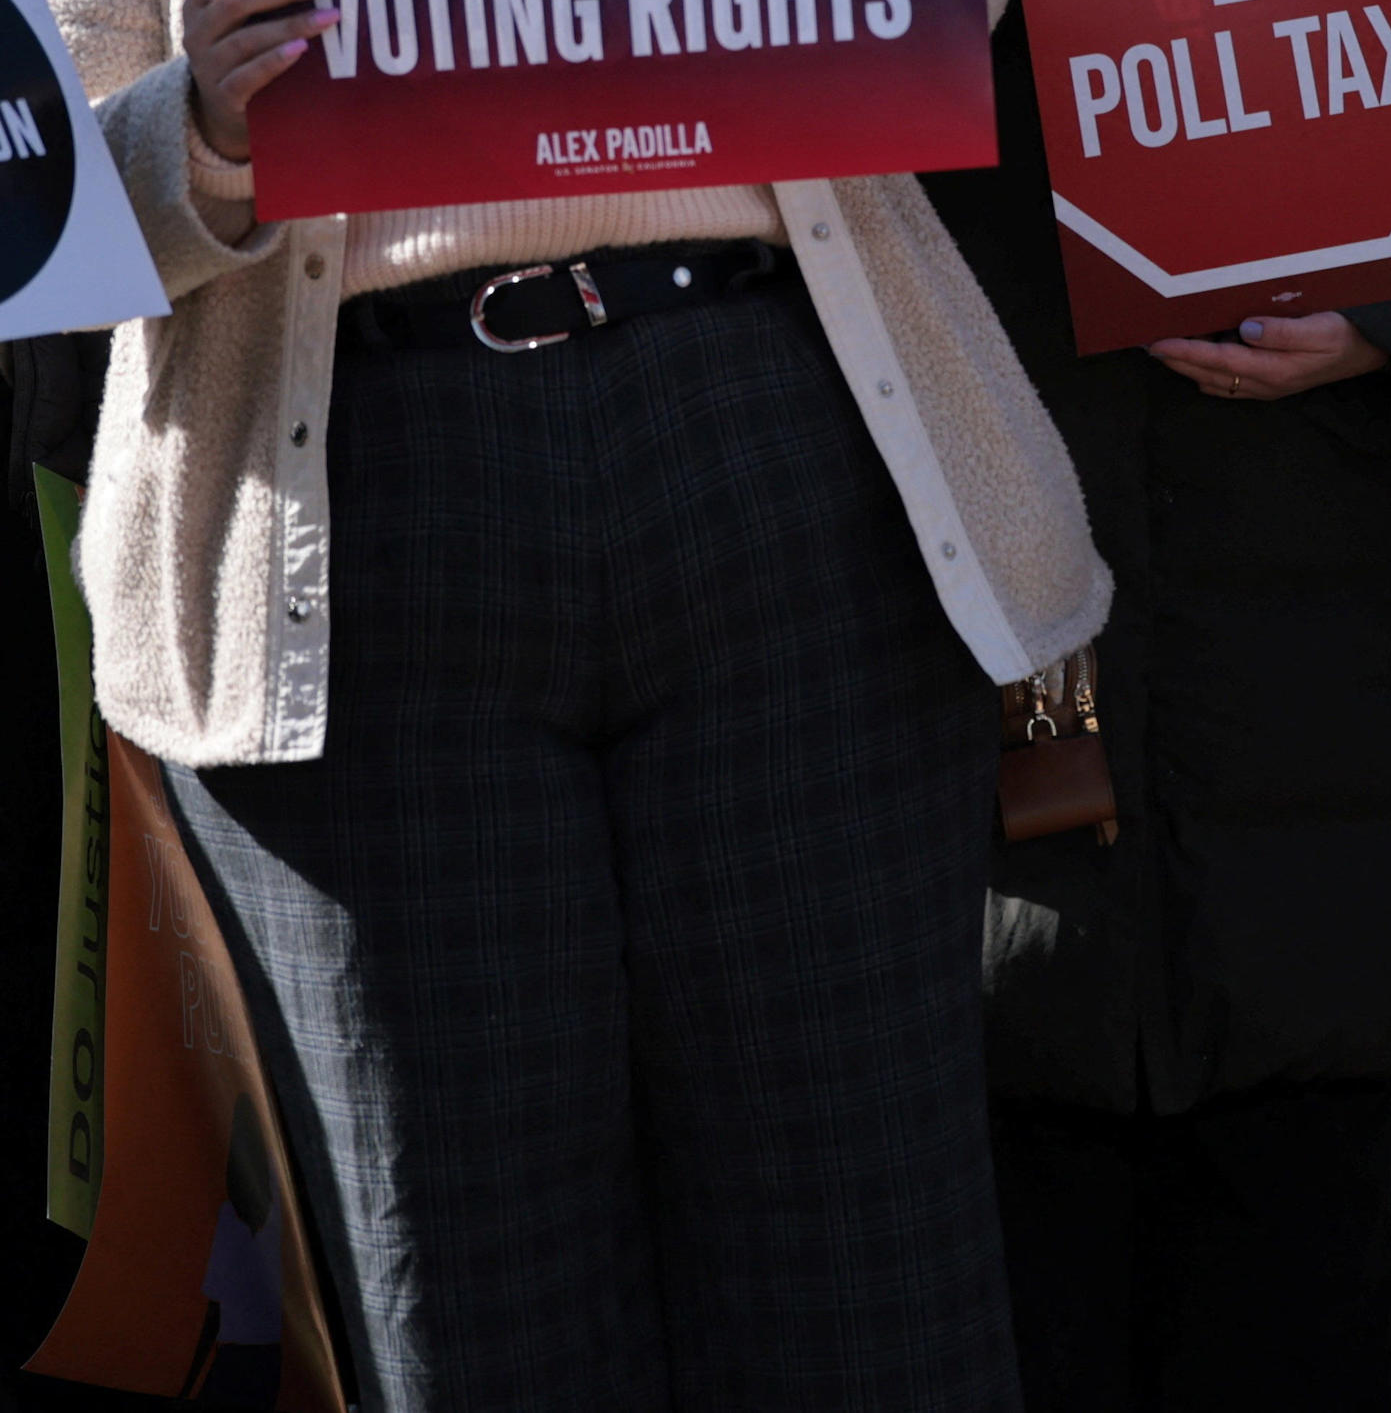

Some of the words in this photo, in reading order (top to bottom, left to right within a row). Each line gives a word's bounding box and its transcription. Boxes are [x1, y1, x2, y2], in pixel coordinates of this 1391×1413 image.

[536, 129, 601, 165] ALEX
[605, 121, 712, 160] PADILLA
[1069, 30, 1271, 159] POLL
[76, 701, 106, 1002] Justic
